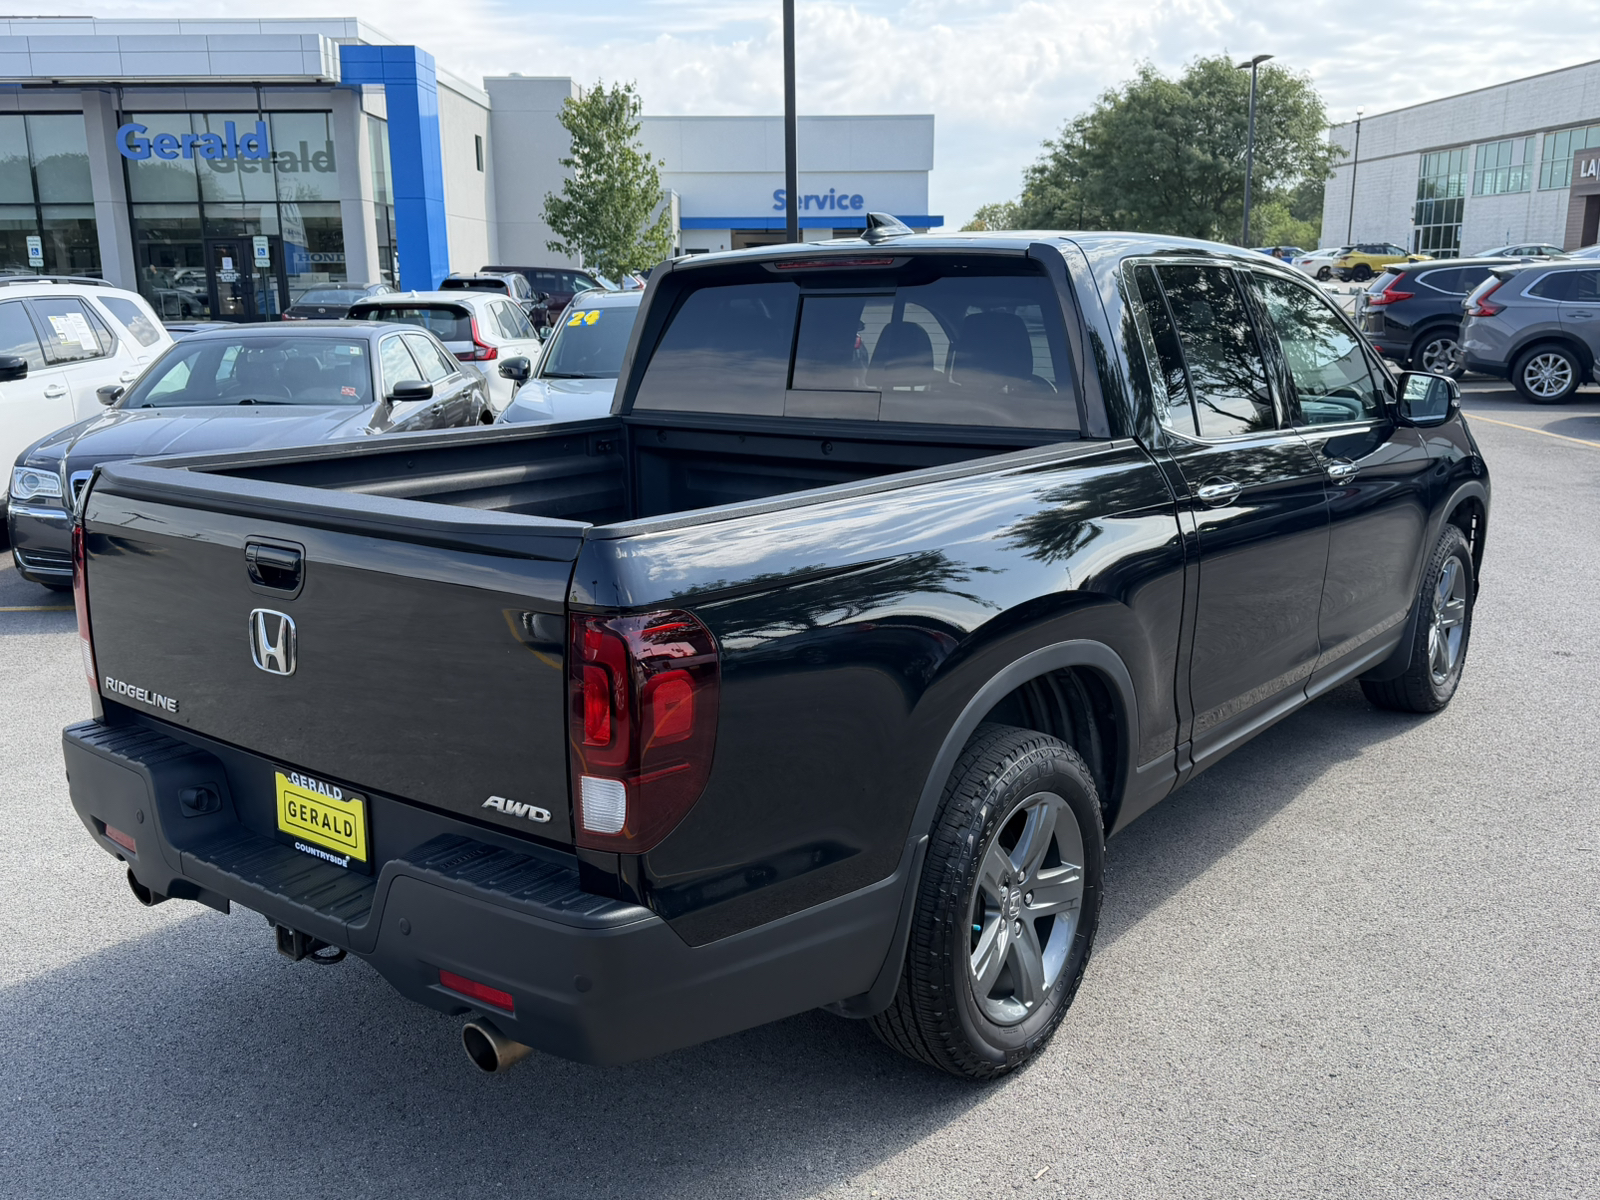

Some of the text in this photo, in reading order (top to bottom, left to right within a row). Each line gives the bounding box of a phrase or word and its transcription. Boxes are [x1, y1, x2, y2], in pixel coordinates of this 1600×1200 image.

[116, 121, 269, 160] Gerald
[773, 188, 864, 210] Srvice
[567, 310, 600, 326] 24
[105, 676, 179, 713] RIDGELINE
[290, 772, 342, 800] GERALD
[288, 800, 353, 837] GERALD
[482, 795, 551, 823] AWD
[295, 842, 348, 867] COUNTRYSIDE
